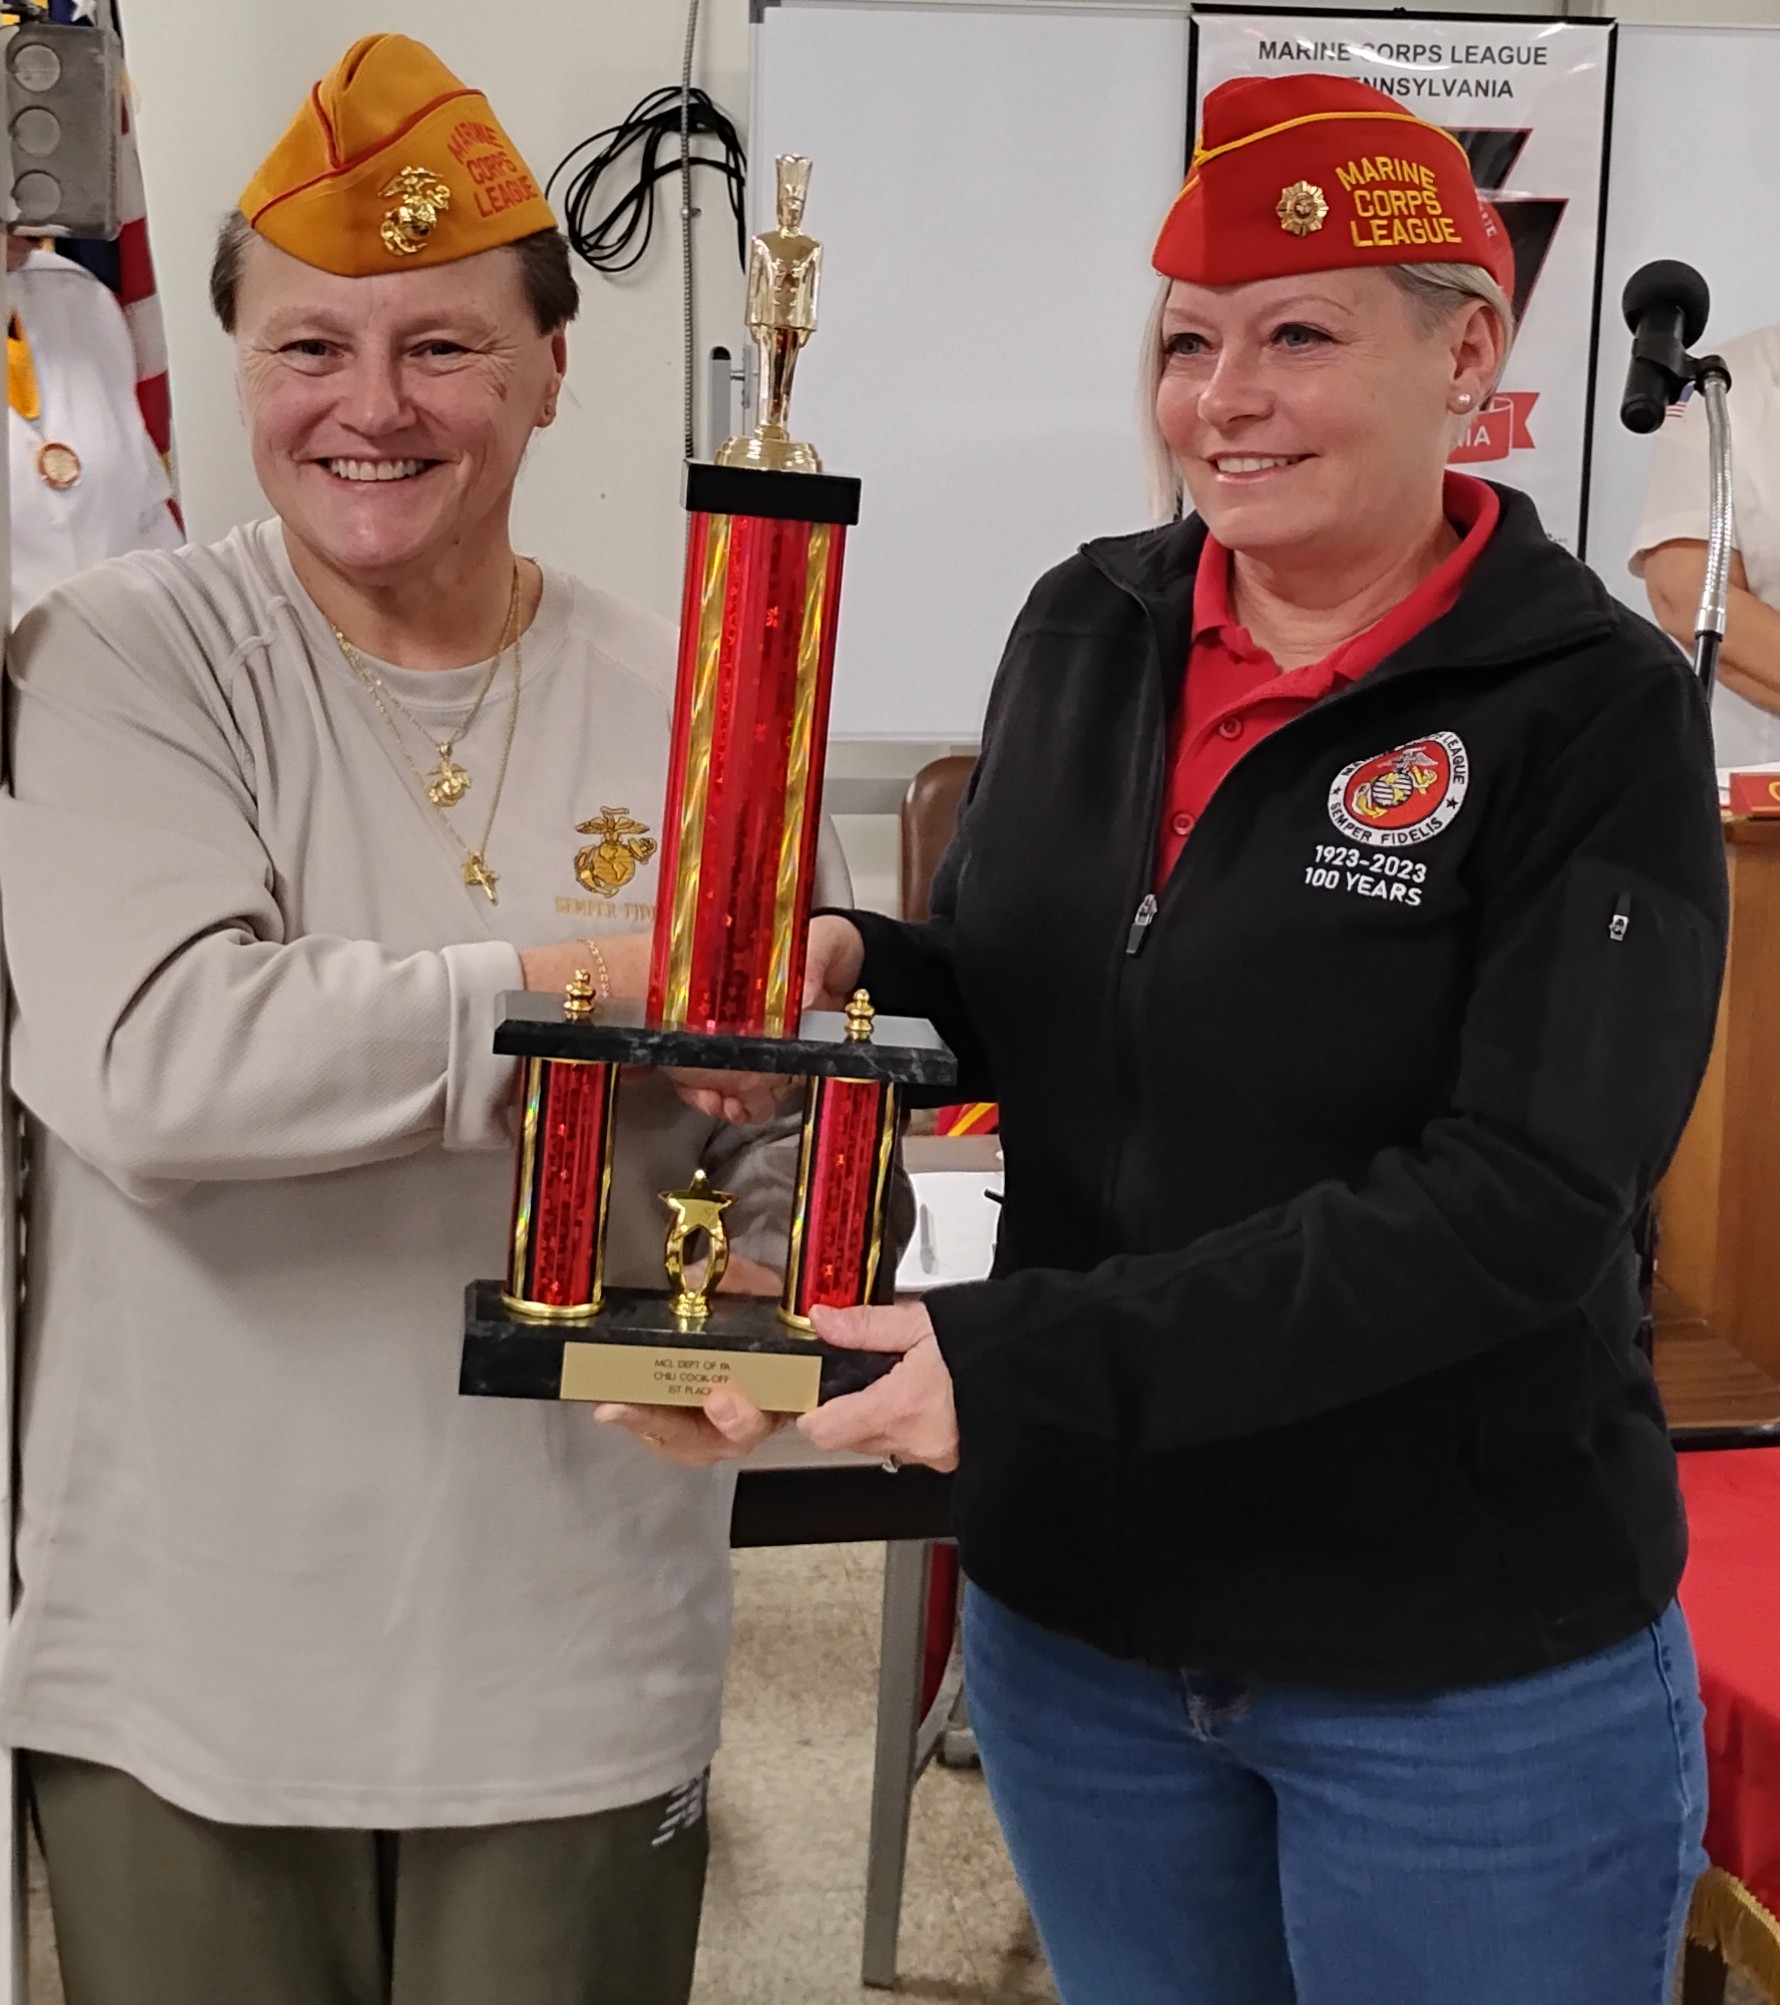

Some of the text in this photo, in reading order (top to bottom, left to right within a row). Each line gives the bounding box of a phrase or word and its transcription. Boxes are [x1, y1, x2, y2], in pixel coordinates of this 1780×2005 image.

[1258, 41, 1548, 65] MARINE ORPS LEAGUE
[447, 120, 504, 165] MARINE
[466, 150, 518, 185] CORPS
[1335, 156, 1438, 192] MARINE
[473, 175, 538, 218] LEAGUE
[1353, 189, 1442, 217] CORPS
[1350, 217, 1462, 248] LEAGUE
[1330, 801, 1443, 845] SEMPER FIDELIS
[1315, 844, 1427, 884] 1923-2023
[1304, 866, 1423, 907] 100 YEARS
[677, 1359, 700, 1369] DEPT
[703, 1360, 717, 1371] OF
